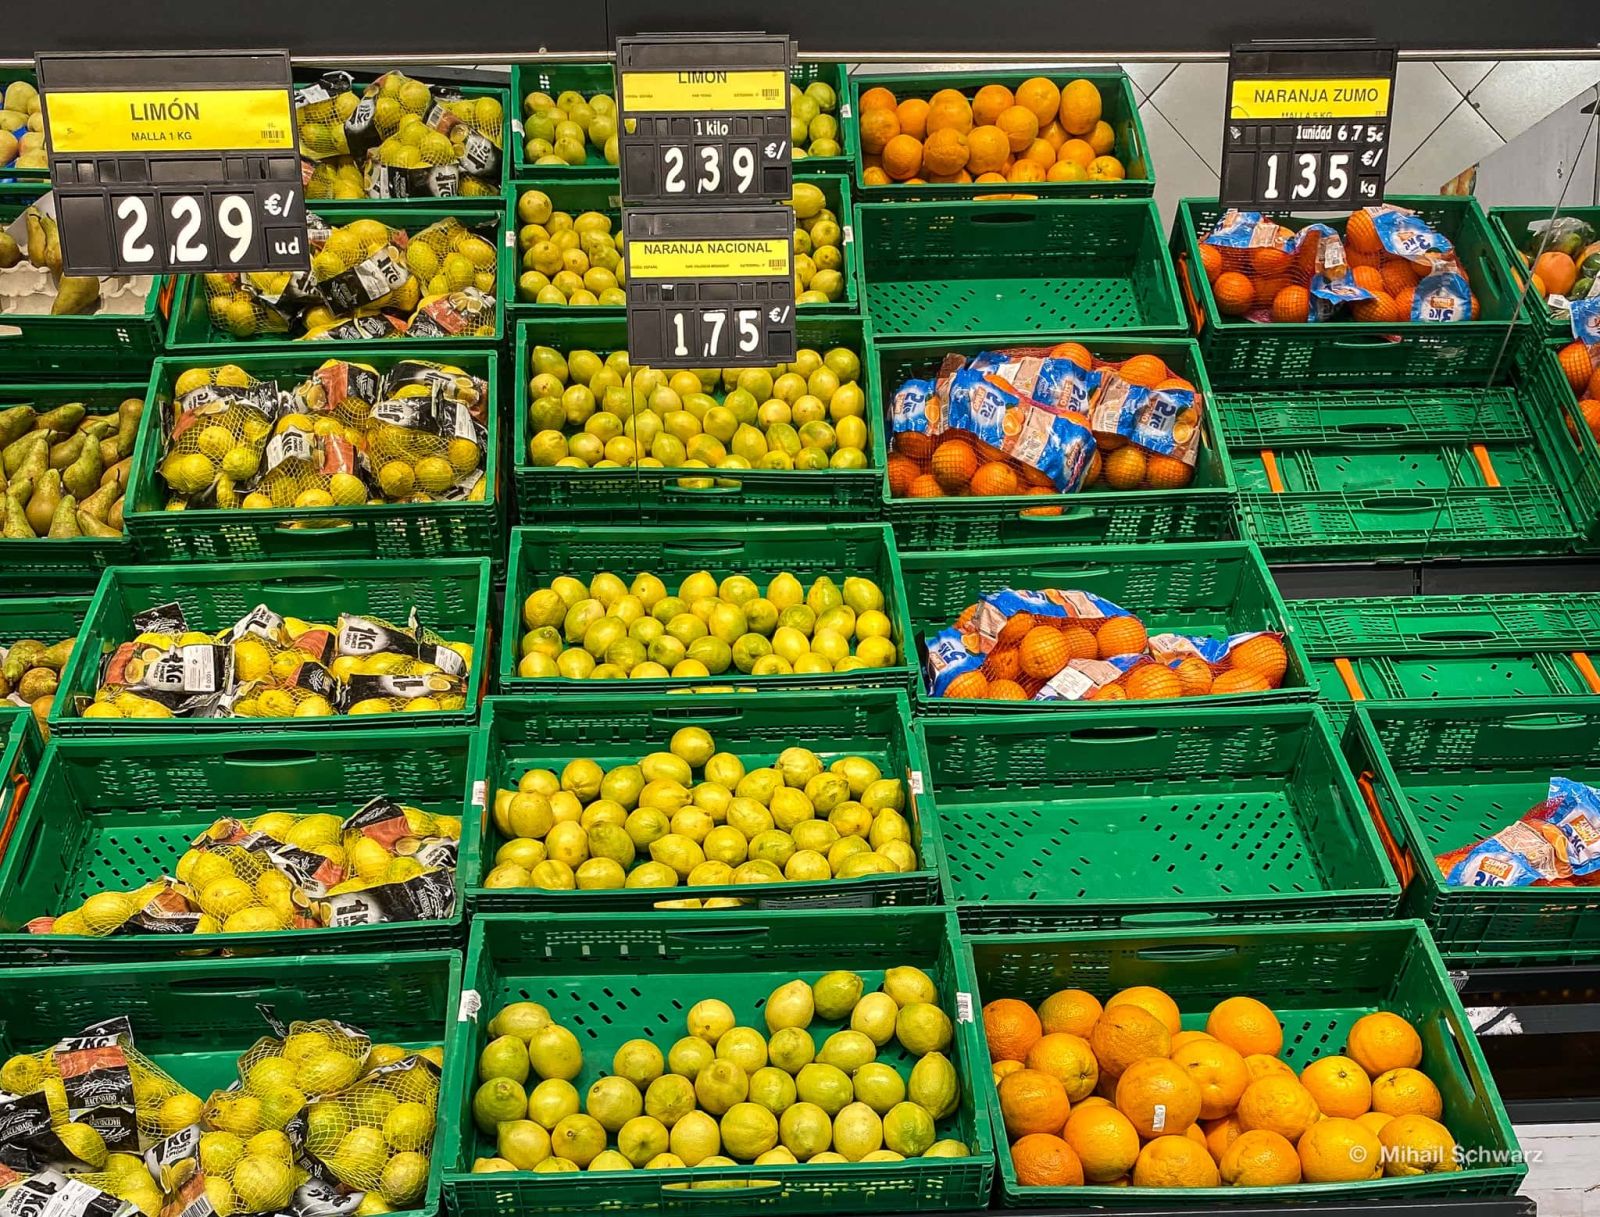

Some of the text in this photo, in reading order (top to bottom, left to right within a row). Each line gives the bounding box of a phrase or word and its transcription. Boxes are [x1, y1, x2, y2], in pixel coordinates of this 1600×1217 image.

[1254, 88, 1378, 103] NARANJA ZUMO
[130, 98, 200, 121] LIMÓN
[697, 121, 729, 135] 1 kilo
[131, 131, 192, 141] MALLA 1 KG
[1360, 181, 1377, 197] kg
[275, 237, 300, 255] ud
[644, 242, 772, 255] NARANJA NACIONAL
